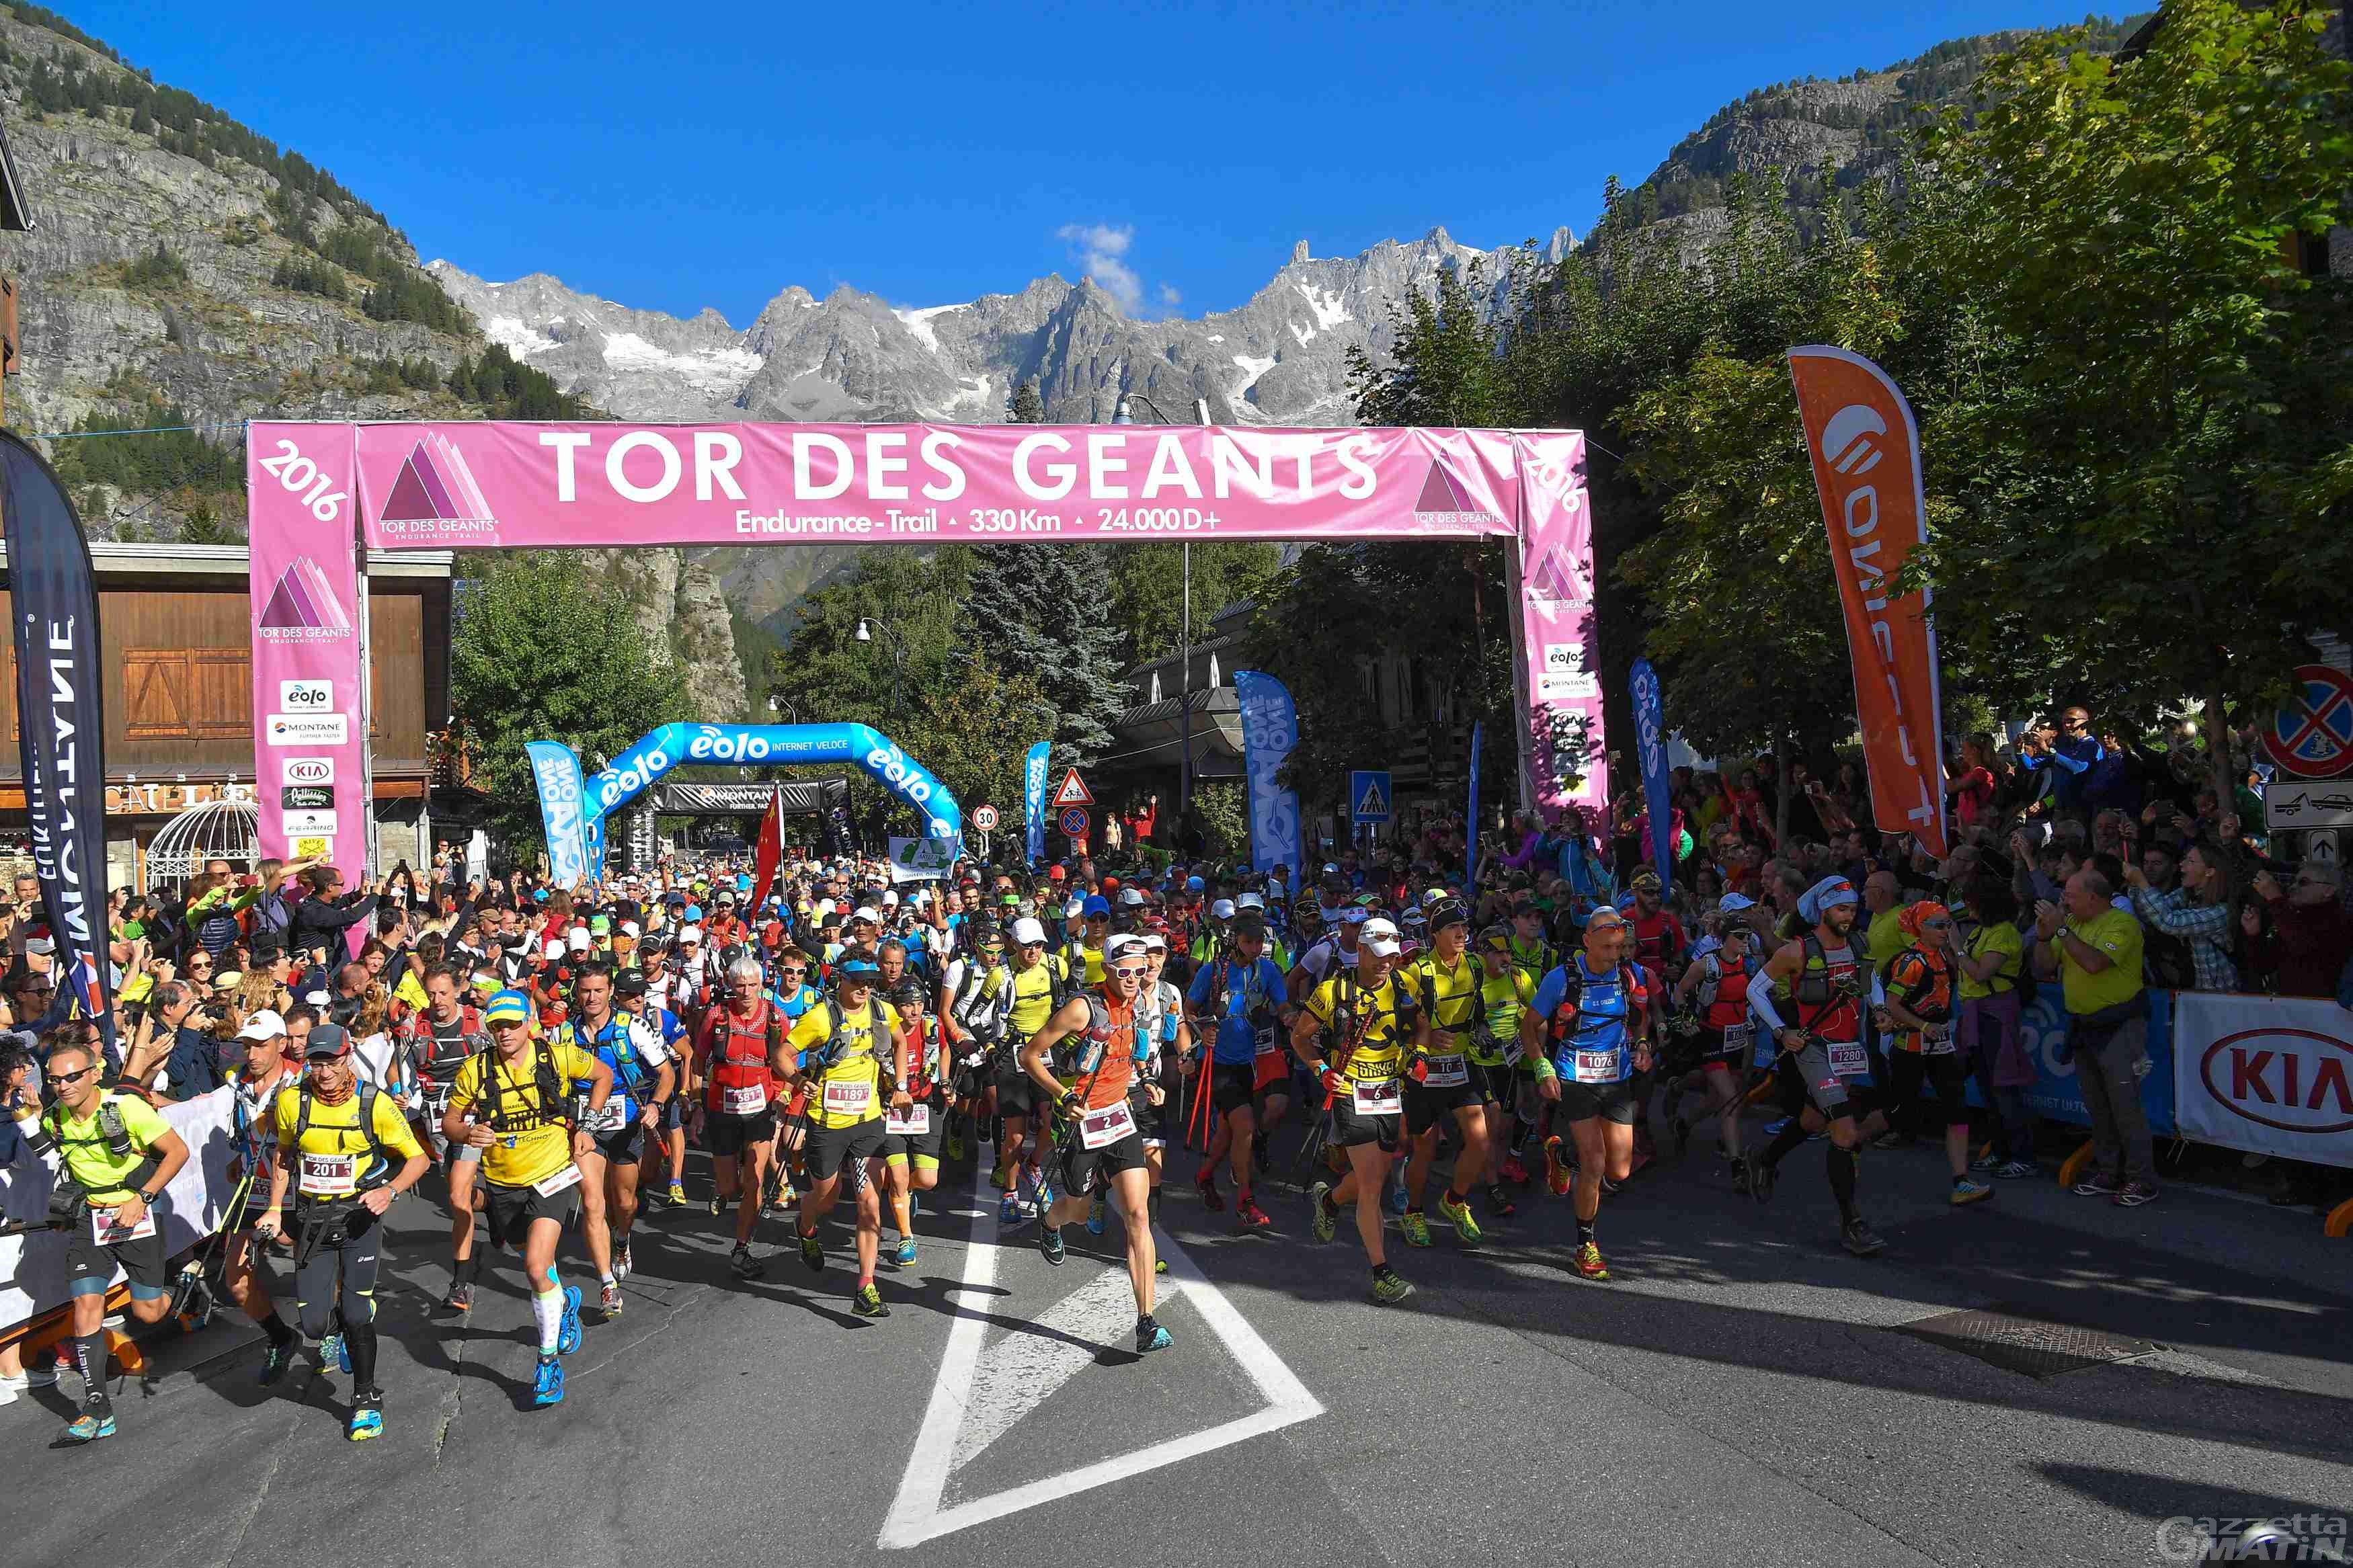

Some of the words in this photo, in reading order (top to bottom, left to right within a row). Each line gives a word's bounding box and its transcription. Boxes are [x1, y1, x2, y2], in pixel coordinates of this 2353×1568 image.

[539, 431, 746, 503] TOR
[793, 431, 966, 501] DES
[1012, 432, 1377, 501] GEANTS
[259, 439, 348, 522] 2016
[1414, 513, 1435, 523] TOR
[1438, 513, 1457, 523] DES
[381, 522, 409, 533] TOR
[412, 522, 434, 532] DES
[440, 520, 494, 532] GEANTS
[259, 628, 282, 638] TOR
[284, 628, 302, 637] DES
[306, 628, 350, 637] GEANTS
[1550, 654, 1579, 666] eolo
[288, 689, 326, 704] eolo
[690, 732, 769, 762] eolo
[772, 742, 813, 751] INTERNET
[816, 741, 848, 749] VELOCE
[296, 766, 323, 777] KIA
[601, 750, 668, 806] eolo
[867, 748, 930, 802] eolo
[715, 791, 772, 800] MONTAN
[979, 812, 993, 825] 30
[1587, 1056, 1613, 1067] 1076
[1839, 1050, 1861, 1061] 1280
[1441, 1063, 1452, 1073] 10
[2230, 1048, 2353, 1114] KIA
[836, 1089, 863, 1100] 1189
[1373, 1089, 1381, 1100] 6
[1103, 1116, 1112, 1129] 2
[313, 1163, 337, 1177] 201
